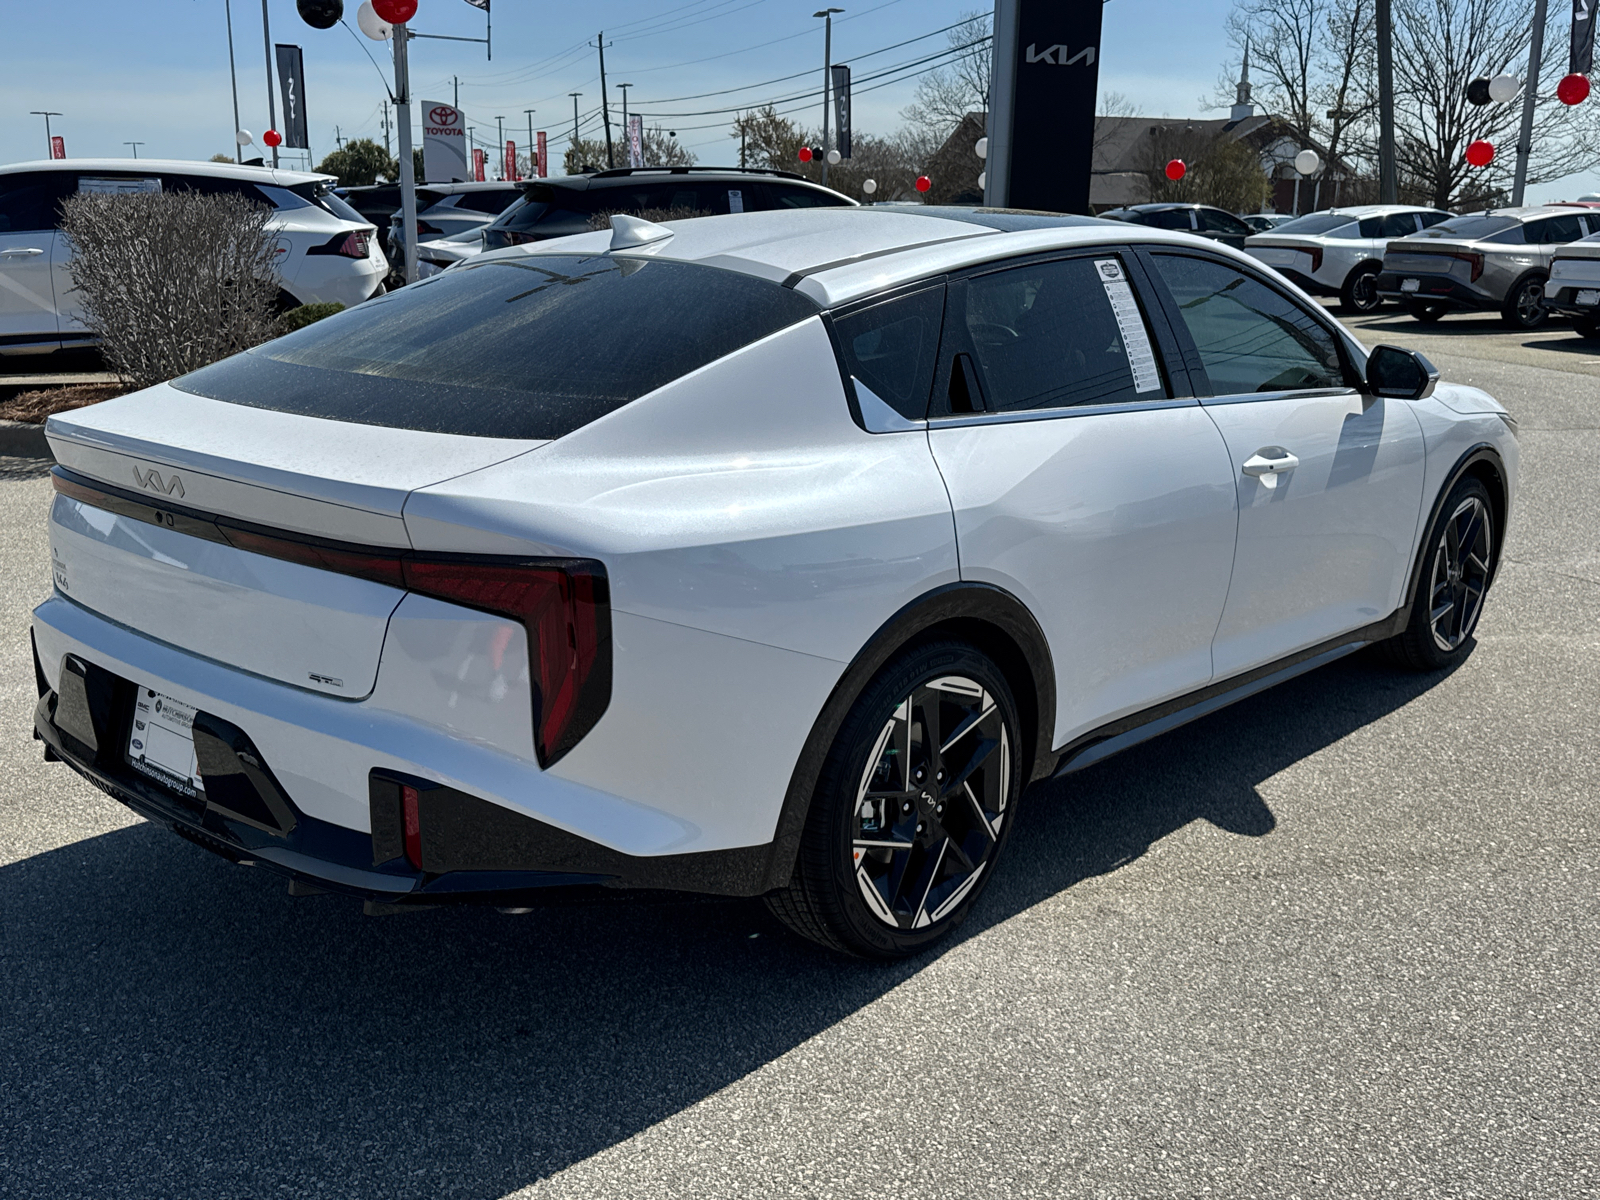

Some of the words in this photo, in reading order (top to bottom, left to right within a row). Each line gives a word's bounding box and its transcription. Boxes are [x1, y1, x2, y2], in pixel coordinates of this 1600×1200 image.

[1026, 42, 1096, 67] KIA
[425, 126, 464, 137] TOYOTA
[132, 465, 186, 498] KIA
[921, 791, 937, 808] KIA
